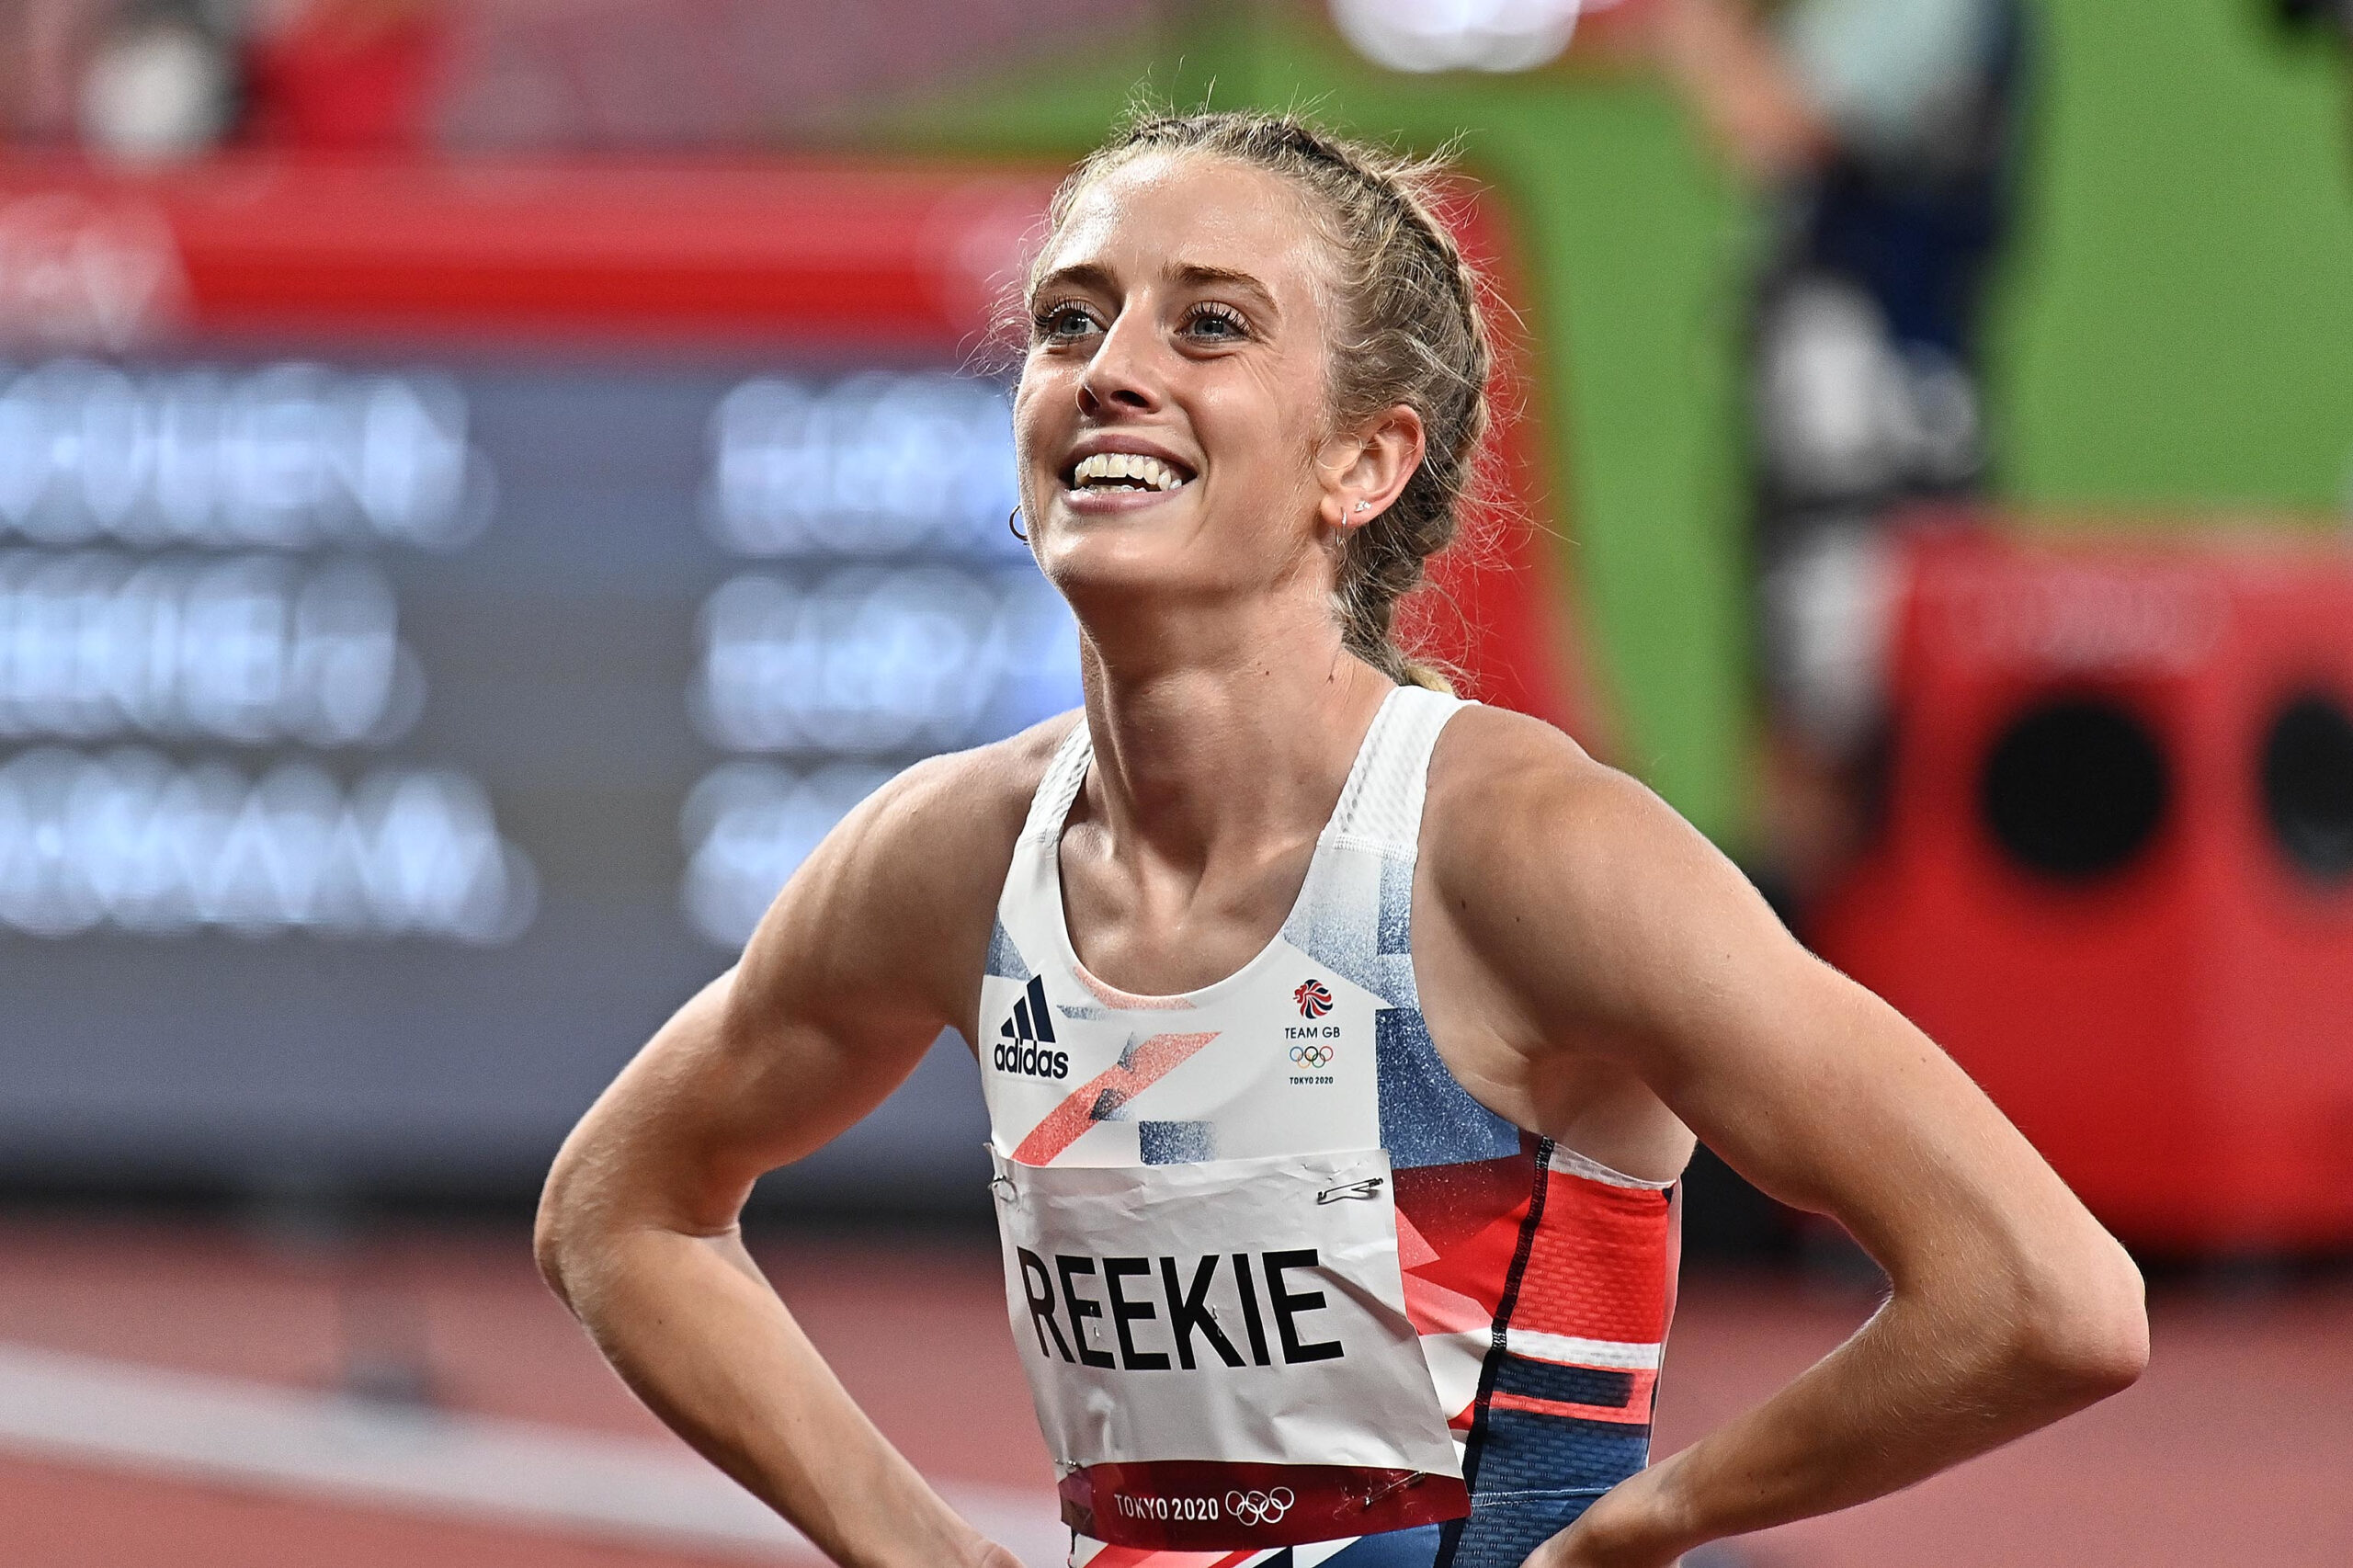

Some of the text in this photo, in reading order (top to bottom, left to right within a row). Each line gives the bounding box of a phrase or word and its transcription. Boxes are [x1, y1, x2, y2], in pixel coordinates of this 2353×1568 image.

[1285, 1027, 1340, 1039] TEAM GB
[994, 1037, 1069, 1080] adidas
[1315, 1076, 1334, 1085] 2020
[1017, 1245, 1345, 1371] REEKIE
[1113, 1494, 1220, 1521] TOKYO 2020
